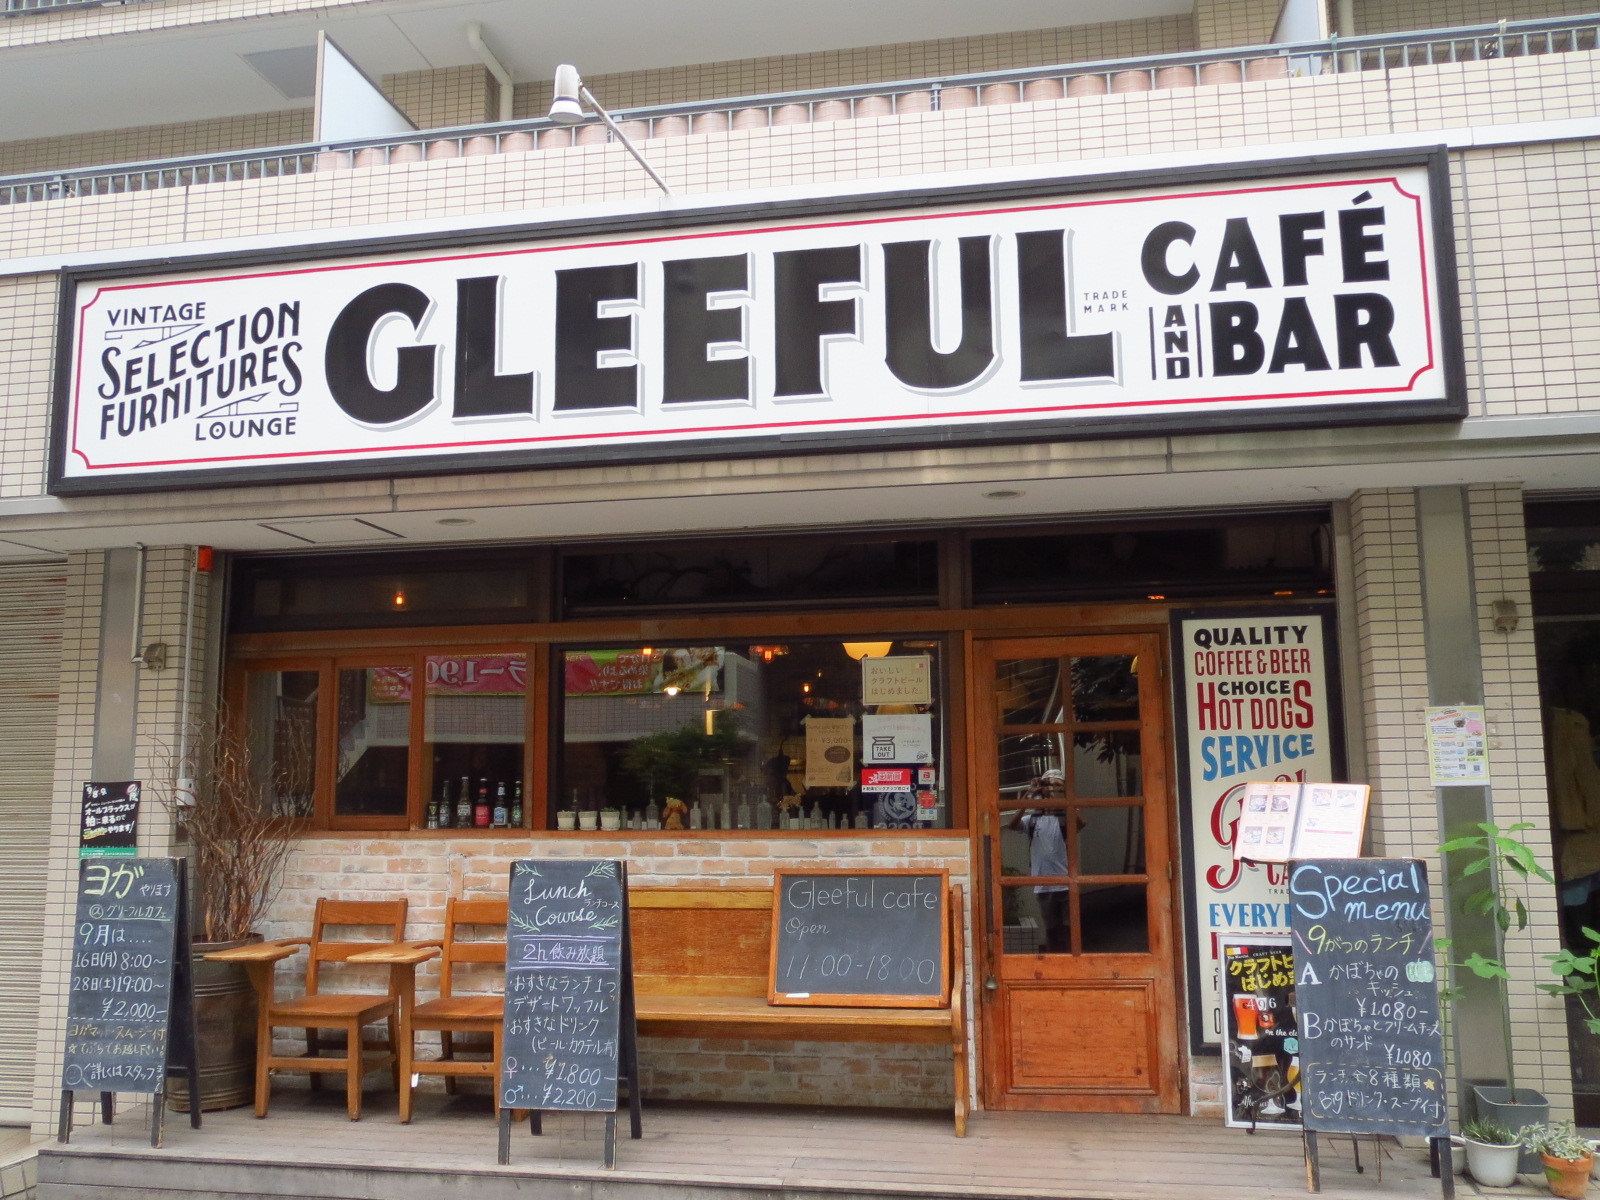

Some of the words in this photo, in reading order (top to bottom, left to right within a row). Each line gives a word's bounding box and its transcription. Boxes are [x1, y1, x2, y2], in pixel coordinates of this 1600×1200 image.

[1141, 190, 1390, 295] CAFÉ
[1084, 290, 1128, 301] TRADE
[1084, 302, 1129, 313] MARK
[107, 302, 206, 326] VINTAGE
[325, 228, 1118, 429] GLEEFUL
[1209, 292, 1400, 377] BAR
[98, 301, 300, 400] SELECTION
[1164, 305, 1190, 379] AND
[100, 341, 303, 440] FURNITURES
[195, 416, 297, 441] LOUNGE
[1194, 626, 1308, 650] QUALITY
[871, 667, 904, 675] おいしい
[1195, 651, 1253, 676] COFFEE
[1270, 648, 1311, 674] BEER
[871, 677, 923, 685] クラフトビール
[1218, 680, 1291, 695] CHOICE
[1197, 682, 1244, 730] HOT
[1250, 680, 1314, 729] DOGS
[1201, 734, 1315, 781] SERVICE
[84, 864, 145, 899] ヨガ
[140, 883, 172, 897] やります
[524, 879, 592, 905] Lunch
[788, 878, 874, 909] Gleeful
[882, 878, 938, 909] cafe
[1290, 863, 1420, 919] Special
[535, 906, 598, 926] Course
[584, 899, 620, 909] ランチコース
[1344, 901, 1430, 922] menu
[785, 917, 829, 940] Open
[1298, 961, 1322, 985] A
[1329, 960, 1398, 980] かぼちゃの
[1367, 981, 1413, 998] キッシュ
[1303, 1012, 1322, 1039] B
[1331, 1035, 1372, 1050] のサンド
